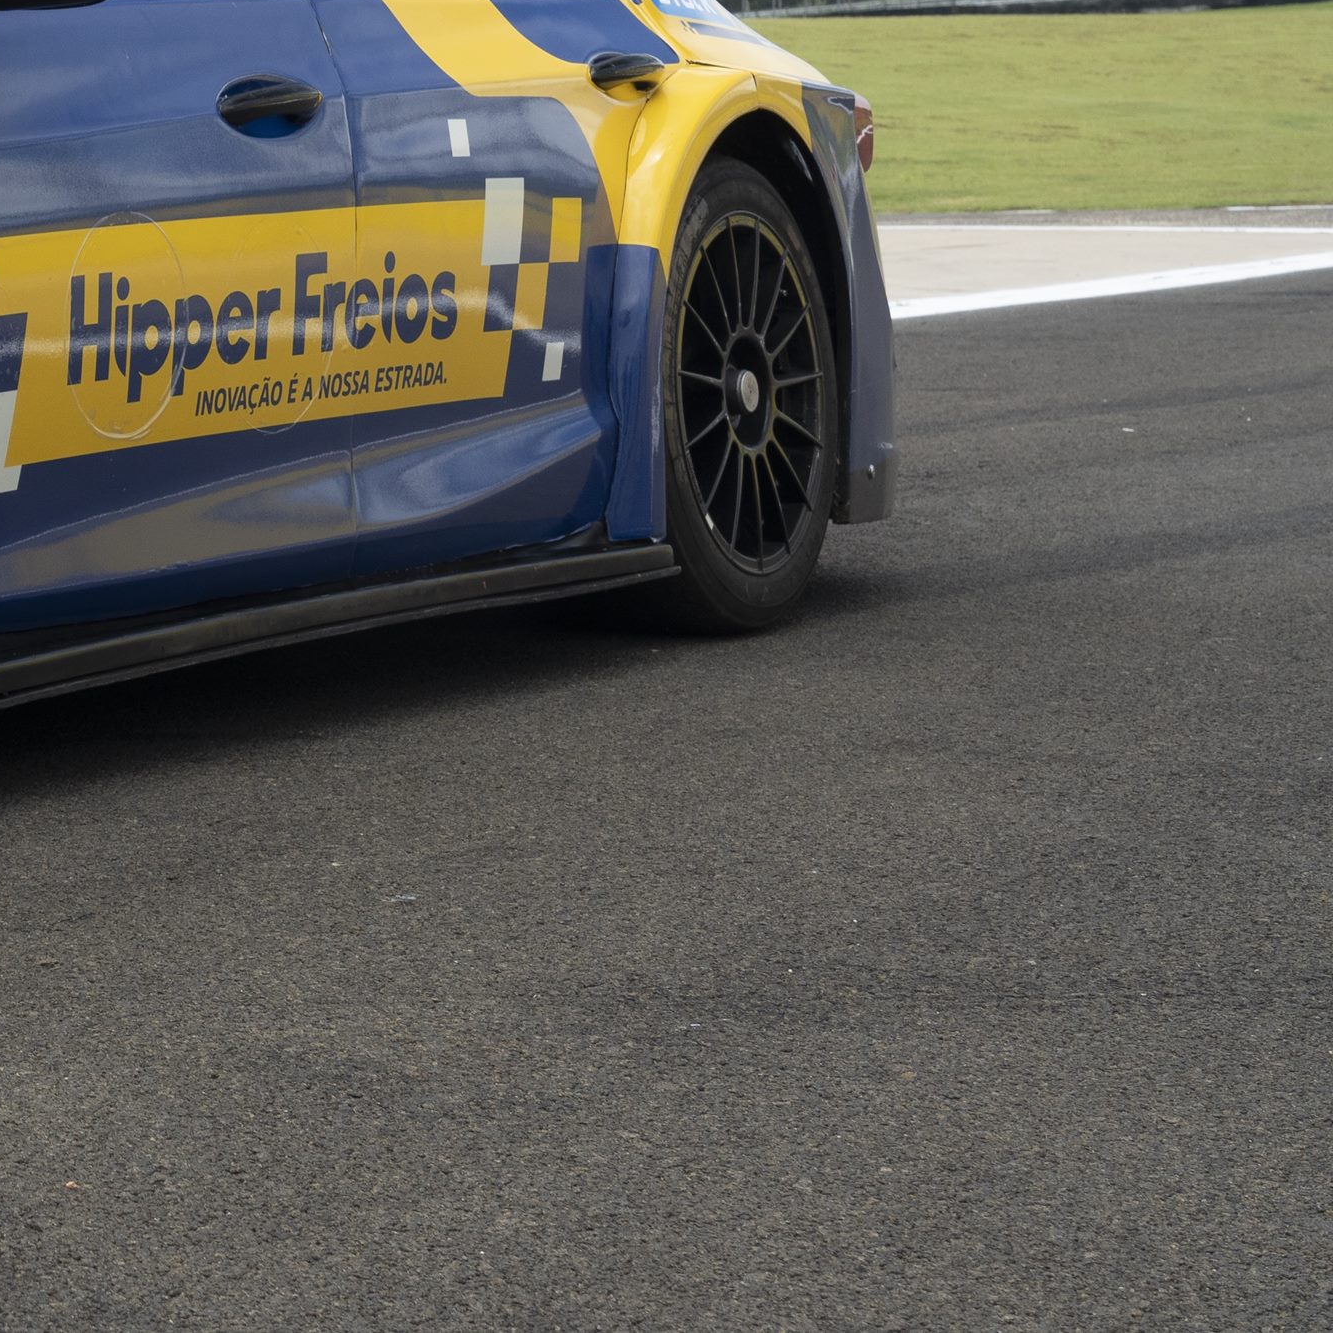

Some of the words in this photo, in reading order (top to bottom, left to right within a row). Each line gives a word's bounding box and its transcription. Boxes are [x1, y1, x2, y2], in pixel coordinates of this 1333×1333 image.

[67, 273, 282, 403] Hipper
[292, 252, 458, 356] Freios
[195, 378, 283, 416] INOVAÇÃO
[286, 370, 299, 404] É
[301, 376, 313, 402] A
[318, 370, 370, 400] NOSSA
[373, 361, 448, 393] ESTRADA.
